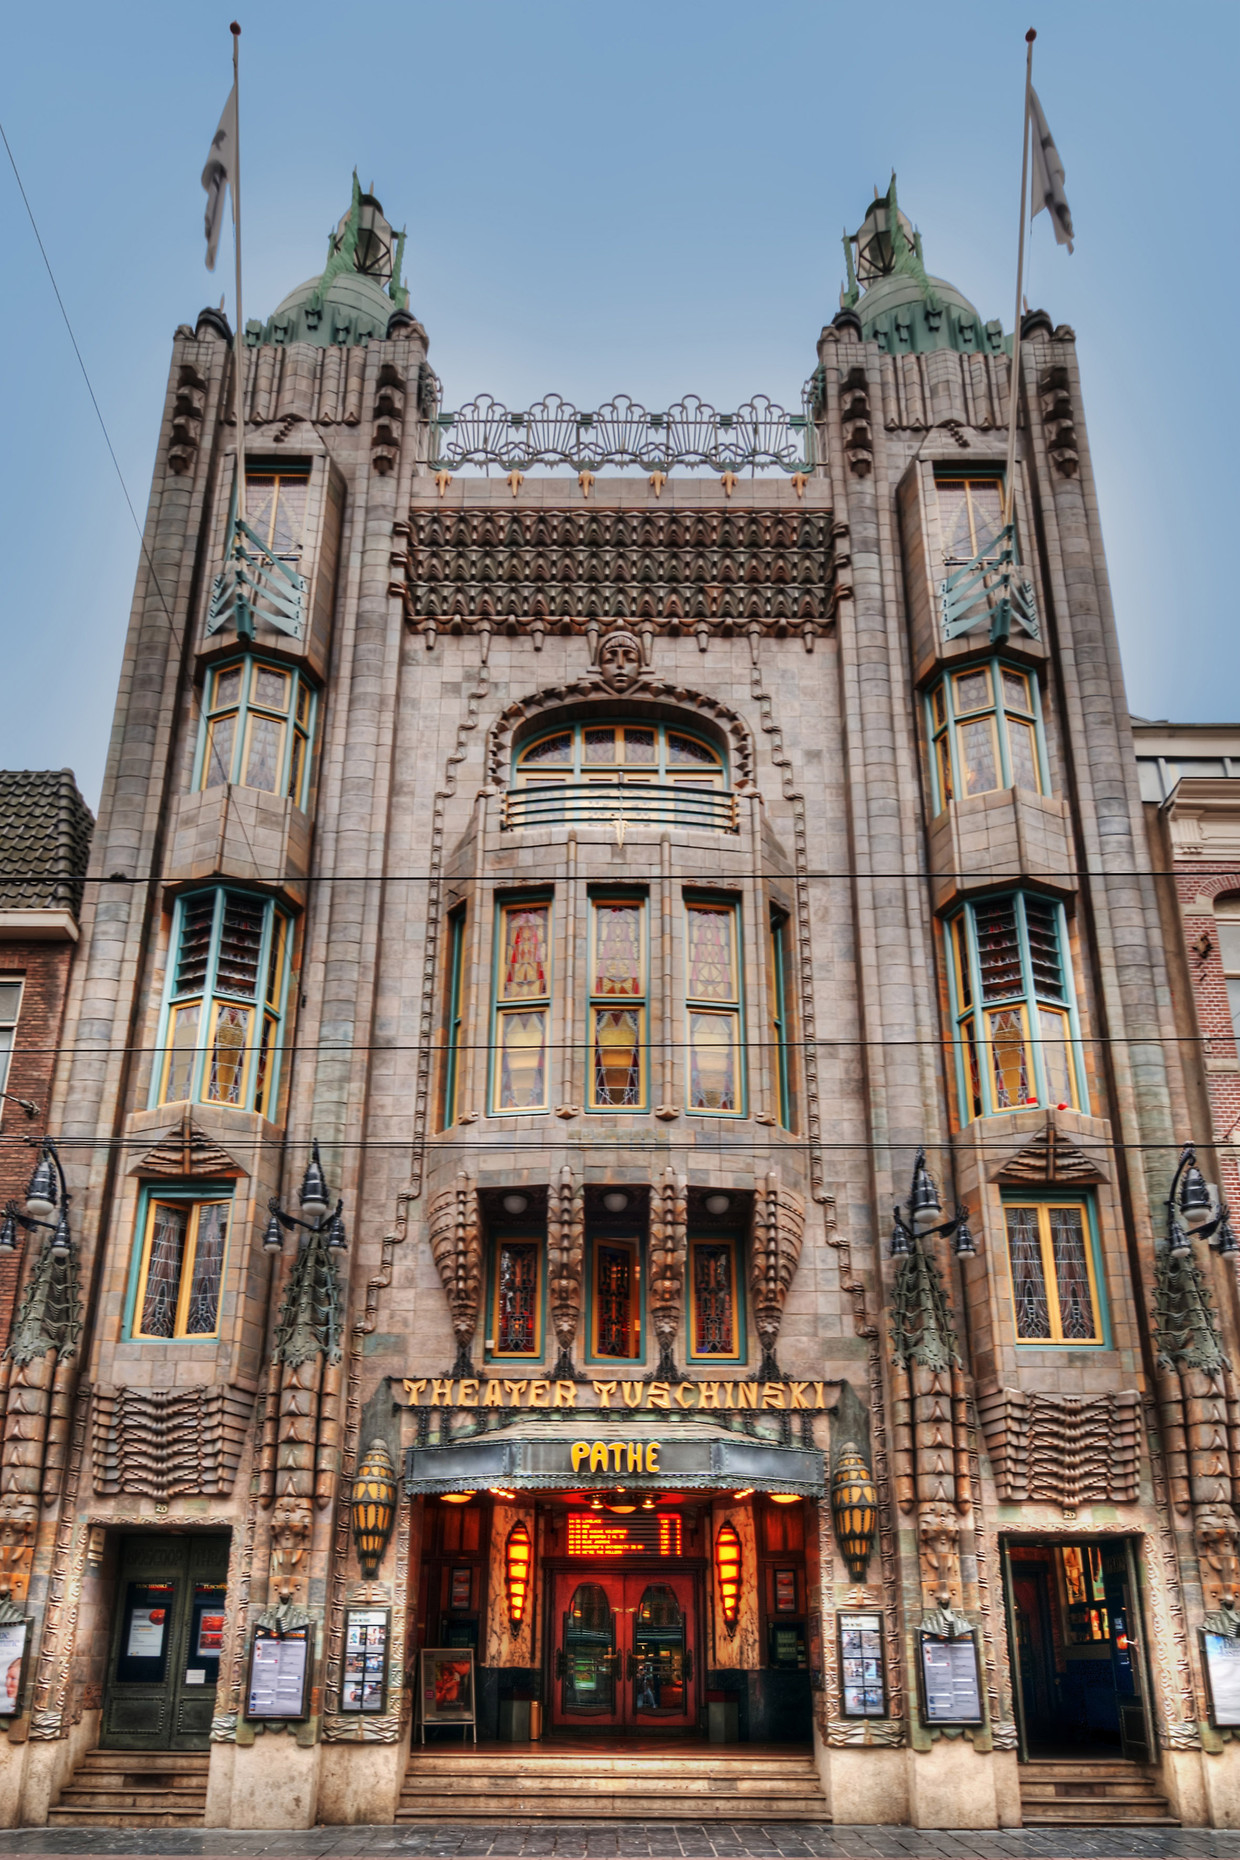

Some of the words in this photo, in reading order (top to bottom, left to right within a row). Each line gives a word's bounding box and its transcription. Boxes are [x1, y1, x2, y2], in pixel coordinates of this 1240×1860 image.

[402, 1378, 577, 1407] THEATER
[592, 1380, 824, 1409] TUSCHINSKI
[571, 1441, 662, 1473] PATHE
